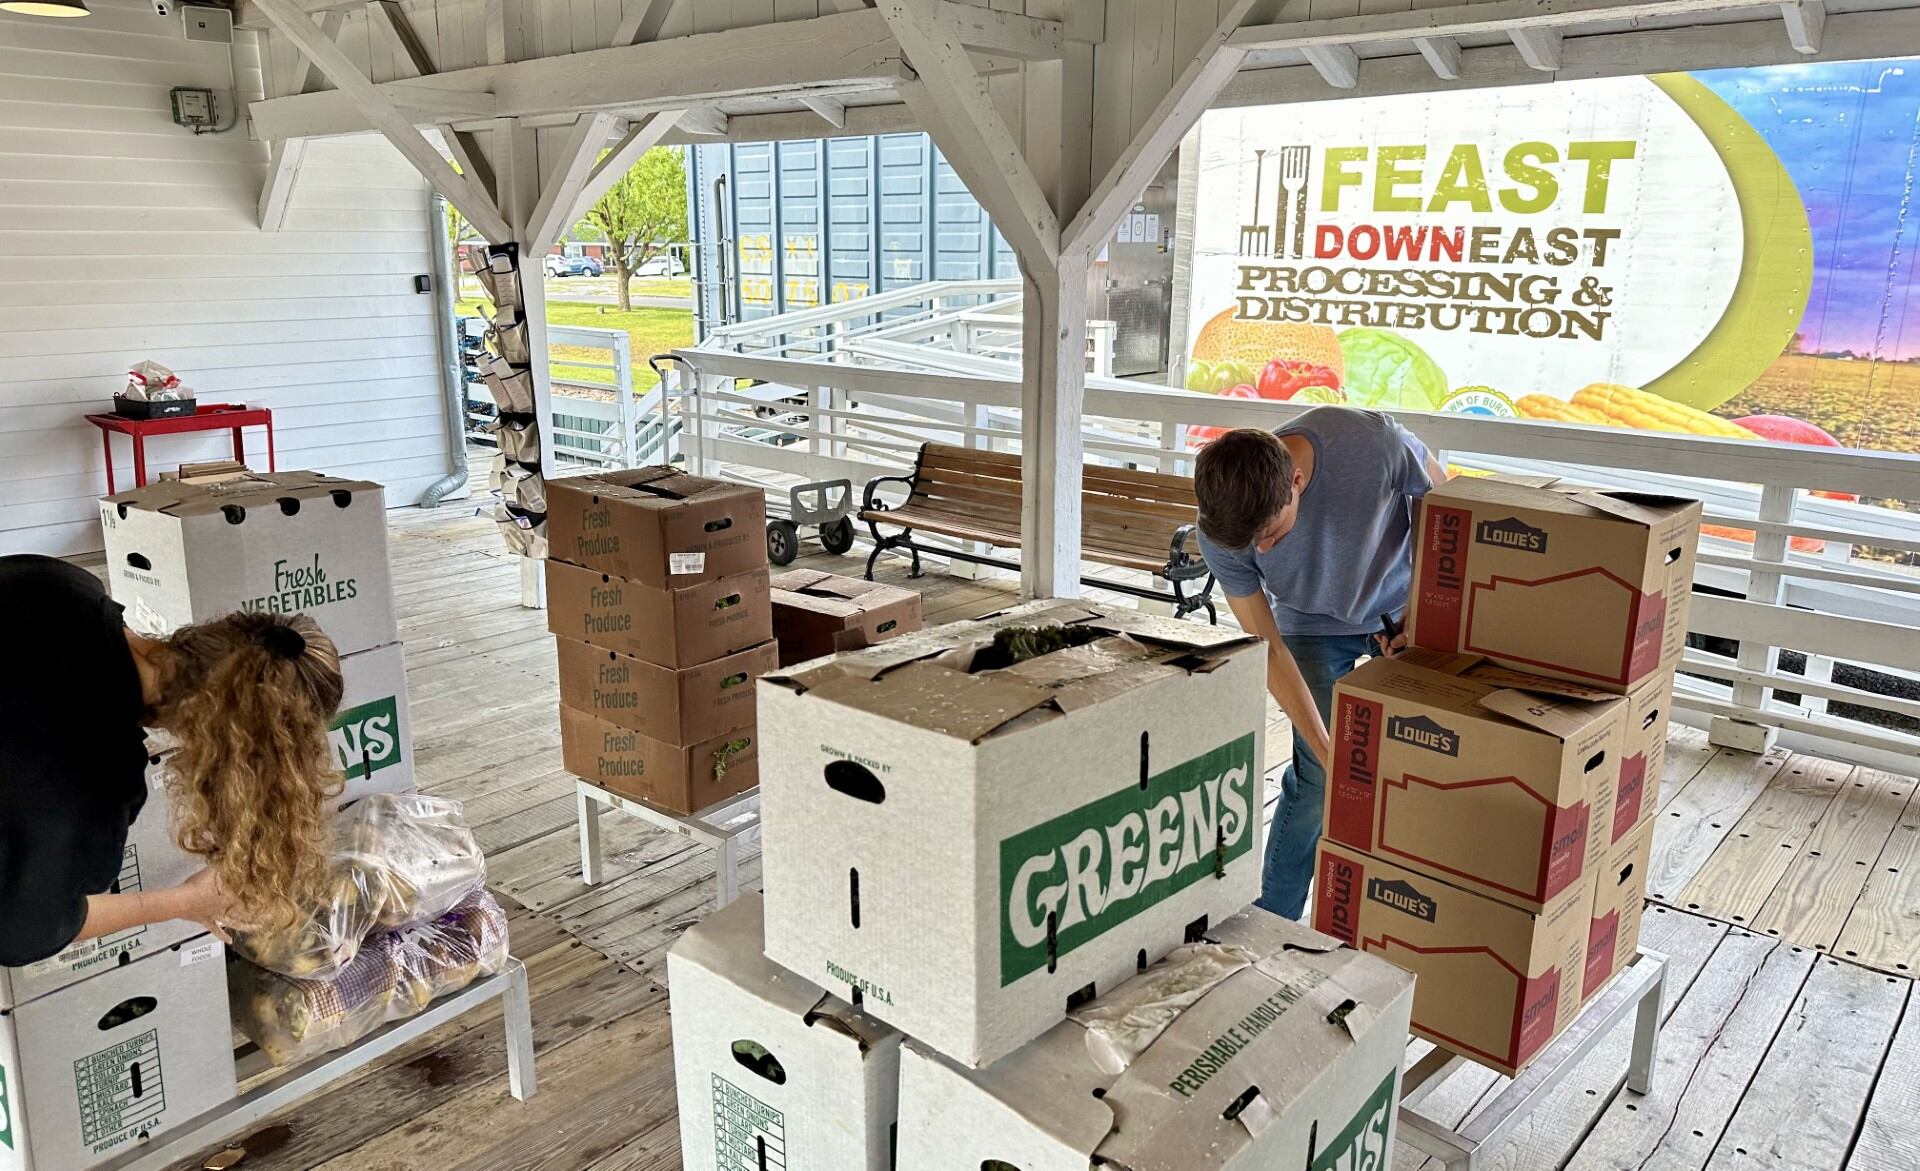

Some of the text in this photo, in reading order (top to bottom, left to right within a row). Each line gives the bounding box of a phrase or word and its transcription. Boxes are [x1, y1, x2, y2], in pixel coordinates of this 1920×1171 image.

[1320, 140, 1637, 214] FEAST
[1314, 225, 1621, 267] DOWNEAST
[1236, 265, 1614, 308] PROCESSING &
[1234, 296, 1612, 342] DISTRIBUTION
[1466, 395, 1480, 405] OF
[1482, 396, 1509, 417] BURG
[582, 508, 611, 531] Fresh
[577, 532, 620, 557] Produce
[1436, 513, 1461, 590] small
[1482, 524, 1541, 550] LOWE'S
[274, 553, 326, 592] Fresh
[241, 578, 358, 615] VEGETABLES
[590, 586, 622, 610] Fresh
[584, 612, 632, 635] Produce
[599, 662, 629, 685] Fresh
[594, 688, 638, 710] Produce
[603, 731, 636, 753] Fresh
[1350, 705, 1373, 785] small
[1393, 720, 1452, 752] LOWE'S
[598, 756, 645, 779] Produce
[854, 755, 880, 770] PACKED
[882, 763, 891, 774] BY
[1552, 820, 1584, 855] small
[1009, 761, 1248, 948] GREENS
[1332, 862, 1356, 943] small
[1373, 881, 1431, 917] LOWE'S
[109, 945, 118, 957] OF
[826, 960, 895, 1007] PRODUCE OF U.S.A.
[1523, 982, 1555, 1025] small
[91, 1032, 154, 1063] BUNCHED TURNIPS
[92, 1047, 143, 1073] GREEN ONIONS
[1168, 1027, 1250, 1098] PERISHABLE
[1240, 991, 1289, 1038] HANDLE
[93, 1063, 125, 1081] COLLARD
[725, 1084, 781, 1124] BUNCHED TURNIPS
[726, 1096, 769, 1131] GREEN ONIONS
[93, 1117, 162, 1154] PRODUCE OF U.S.A.
[101, 1120, 123, 1136] OTHER
[727, 1110, 753, 1134] COLLARD
[728, 1135, 756, 1160] MUSTARD
